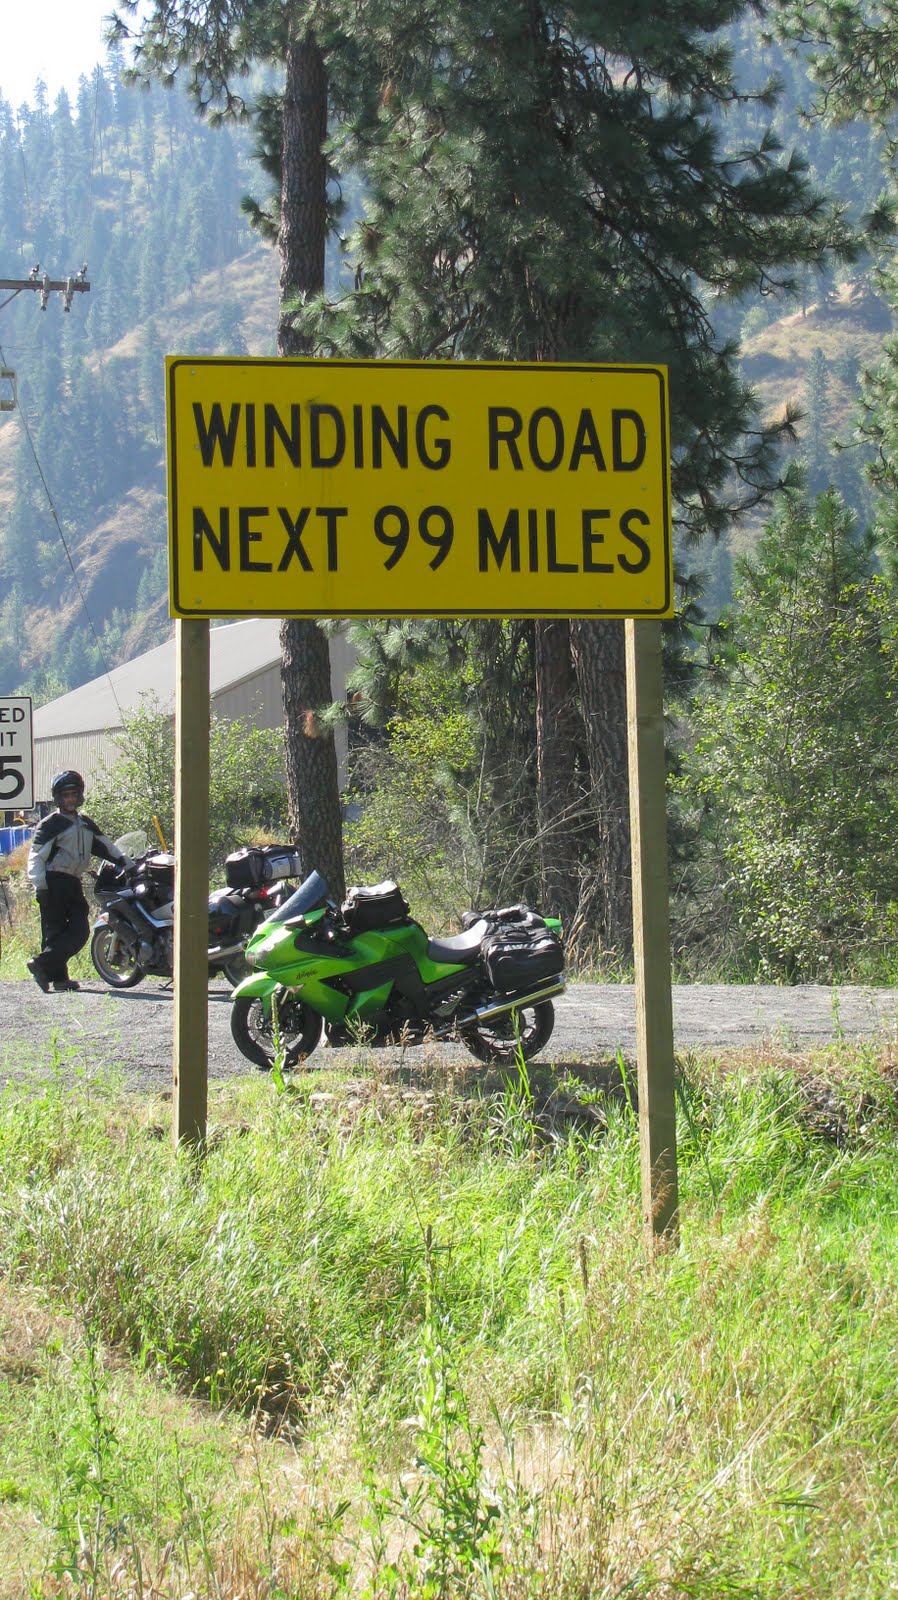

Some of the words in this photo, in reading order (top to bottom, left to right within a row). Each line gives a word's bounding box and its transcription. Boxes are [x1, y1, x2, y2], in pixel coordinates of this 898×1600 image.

[192, 402, 452, 470] WINDING
[488, 406, 647, 472] ROAD
[193, 506, 349, 573] NEXT
[373, 505, 455, 572] 99
[478, 508, 652, 574] MILES
